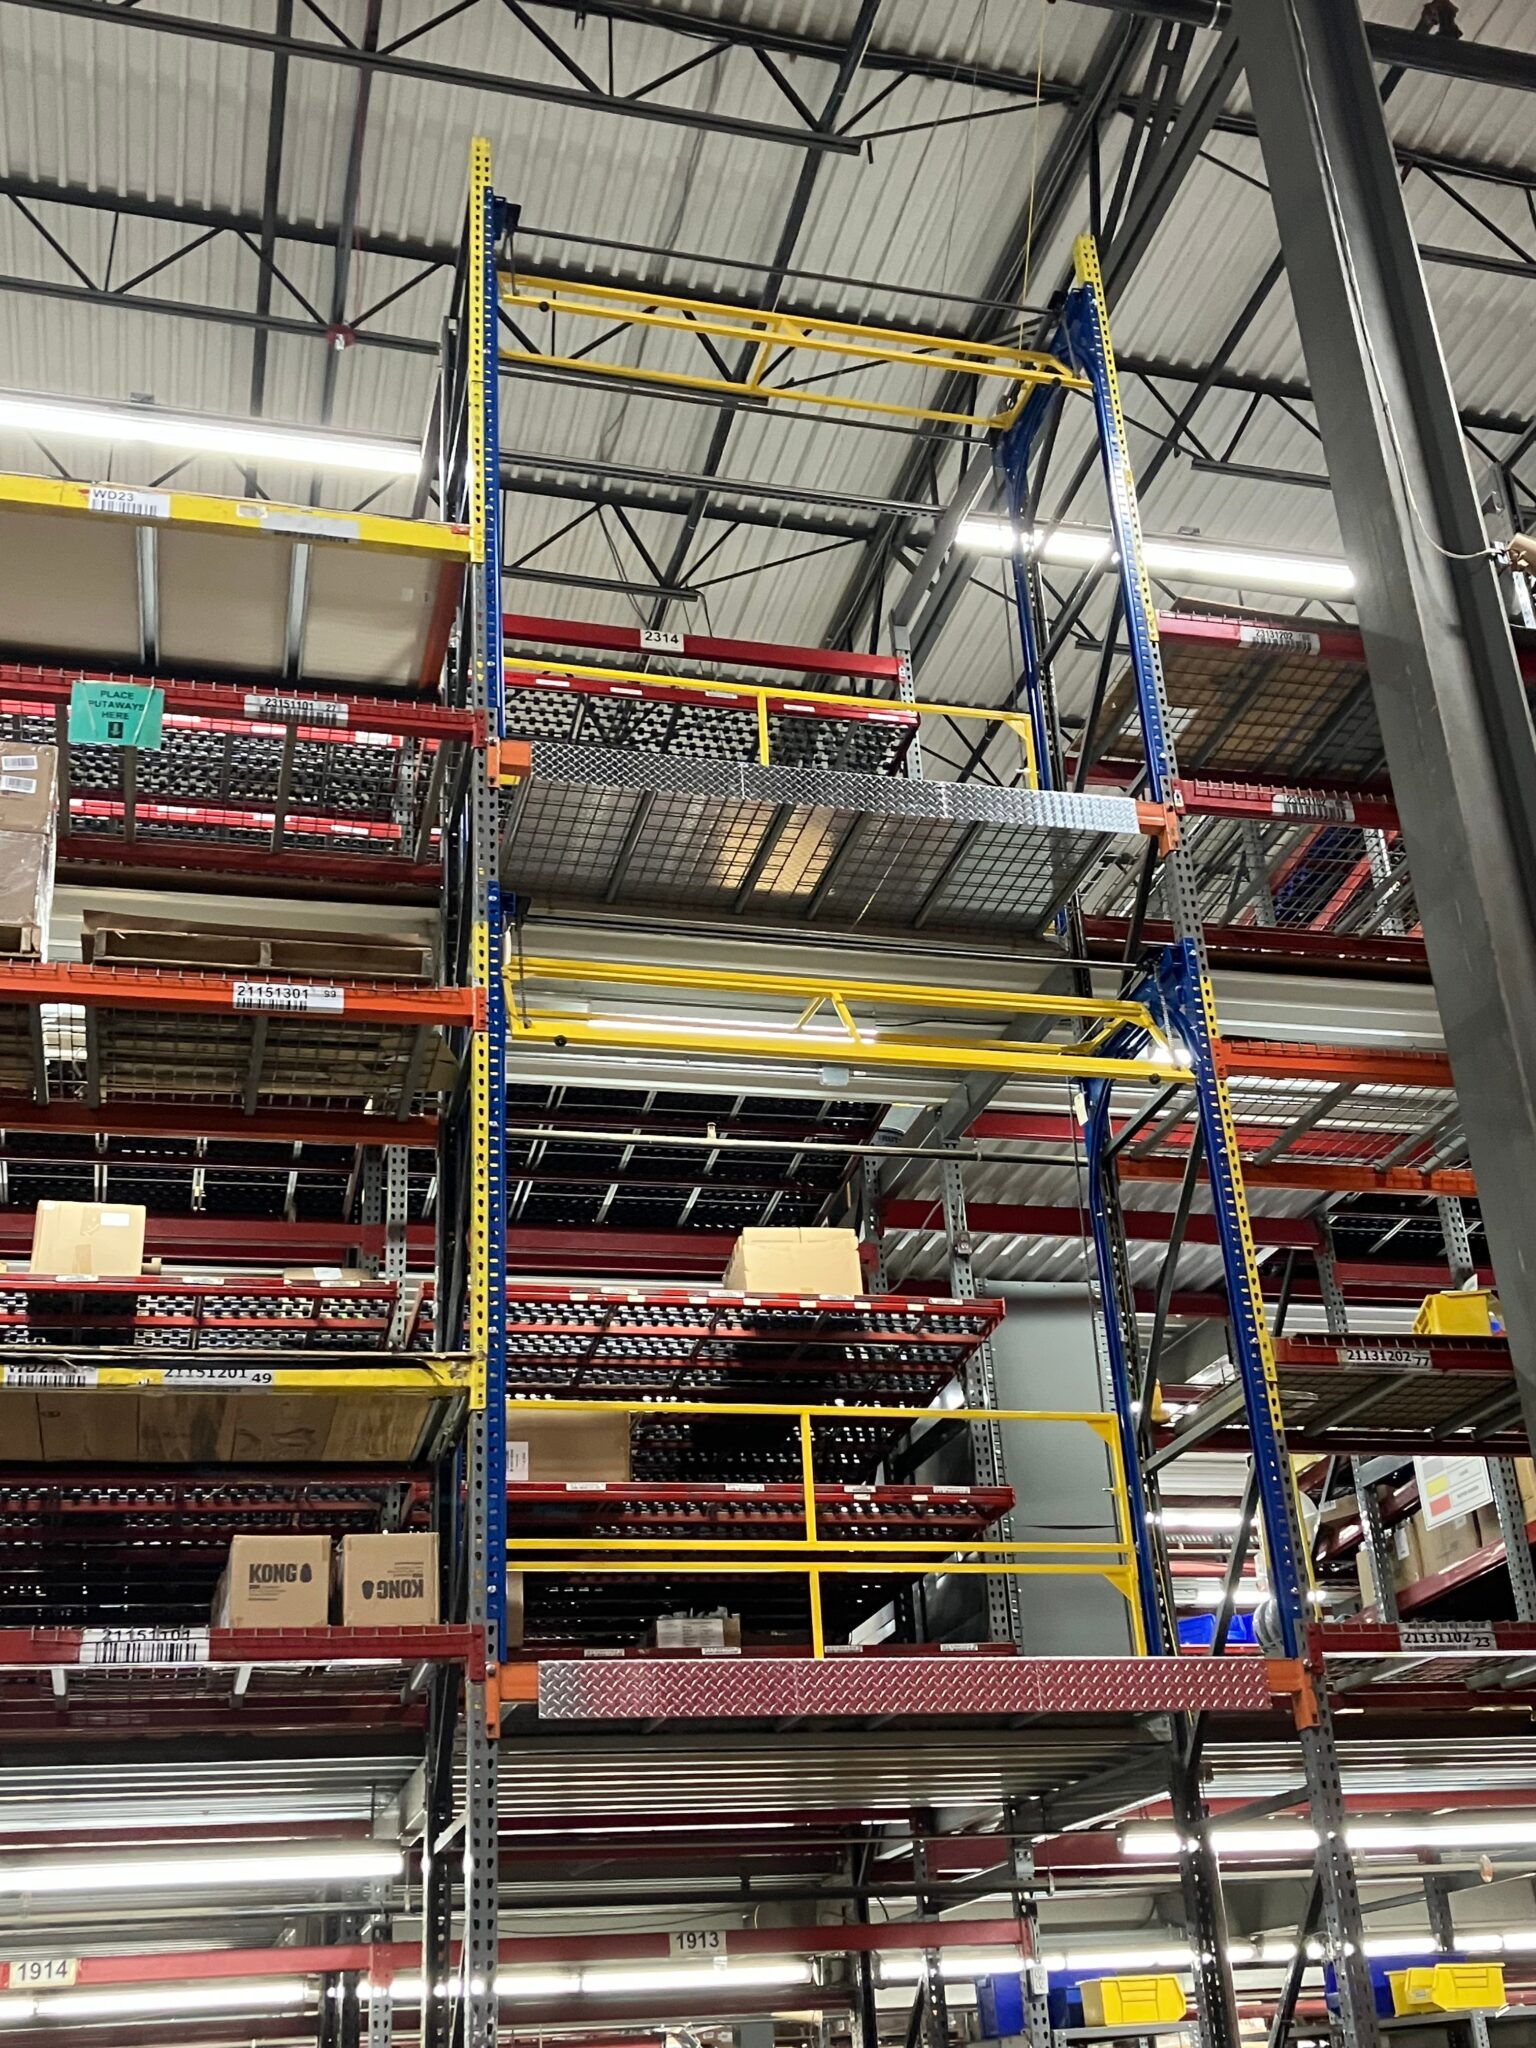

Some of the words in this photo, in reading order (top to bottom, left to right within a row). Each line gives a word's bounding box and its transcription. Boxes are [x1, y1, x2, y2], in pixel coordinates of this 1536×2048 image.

[93, 489, 134, 502] WD23
[645, 631, 679, 643] 2314
[100, 690, 134, 700] PLACE
[88, 700, 145, 711] PUTAWAYS
[265, 697, 314, 711] 23151101
[101, 711, 129, 720] HERE
[237, 985, 308, 999] 21151301
[1347, 1349, 1412, 1362] 21131202
[251, 1373, 272, 1383] 49
[249, 1563, 297, 1583] KONG
[376, 1579, 424, 1599] KONG
[1473, 1637, 1490, 1647] 23
[676, 1931, 719, 1950] 1913
[18, 1960, 68, 1981] 1914
